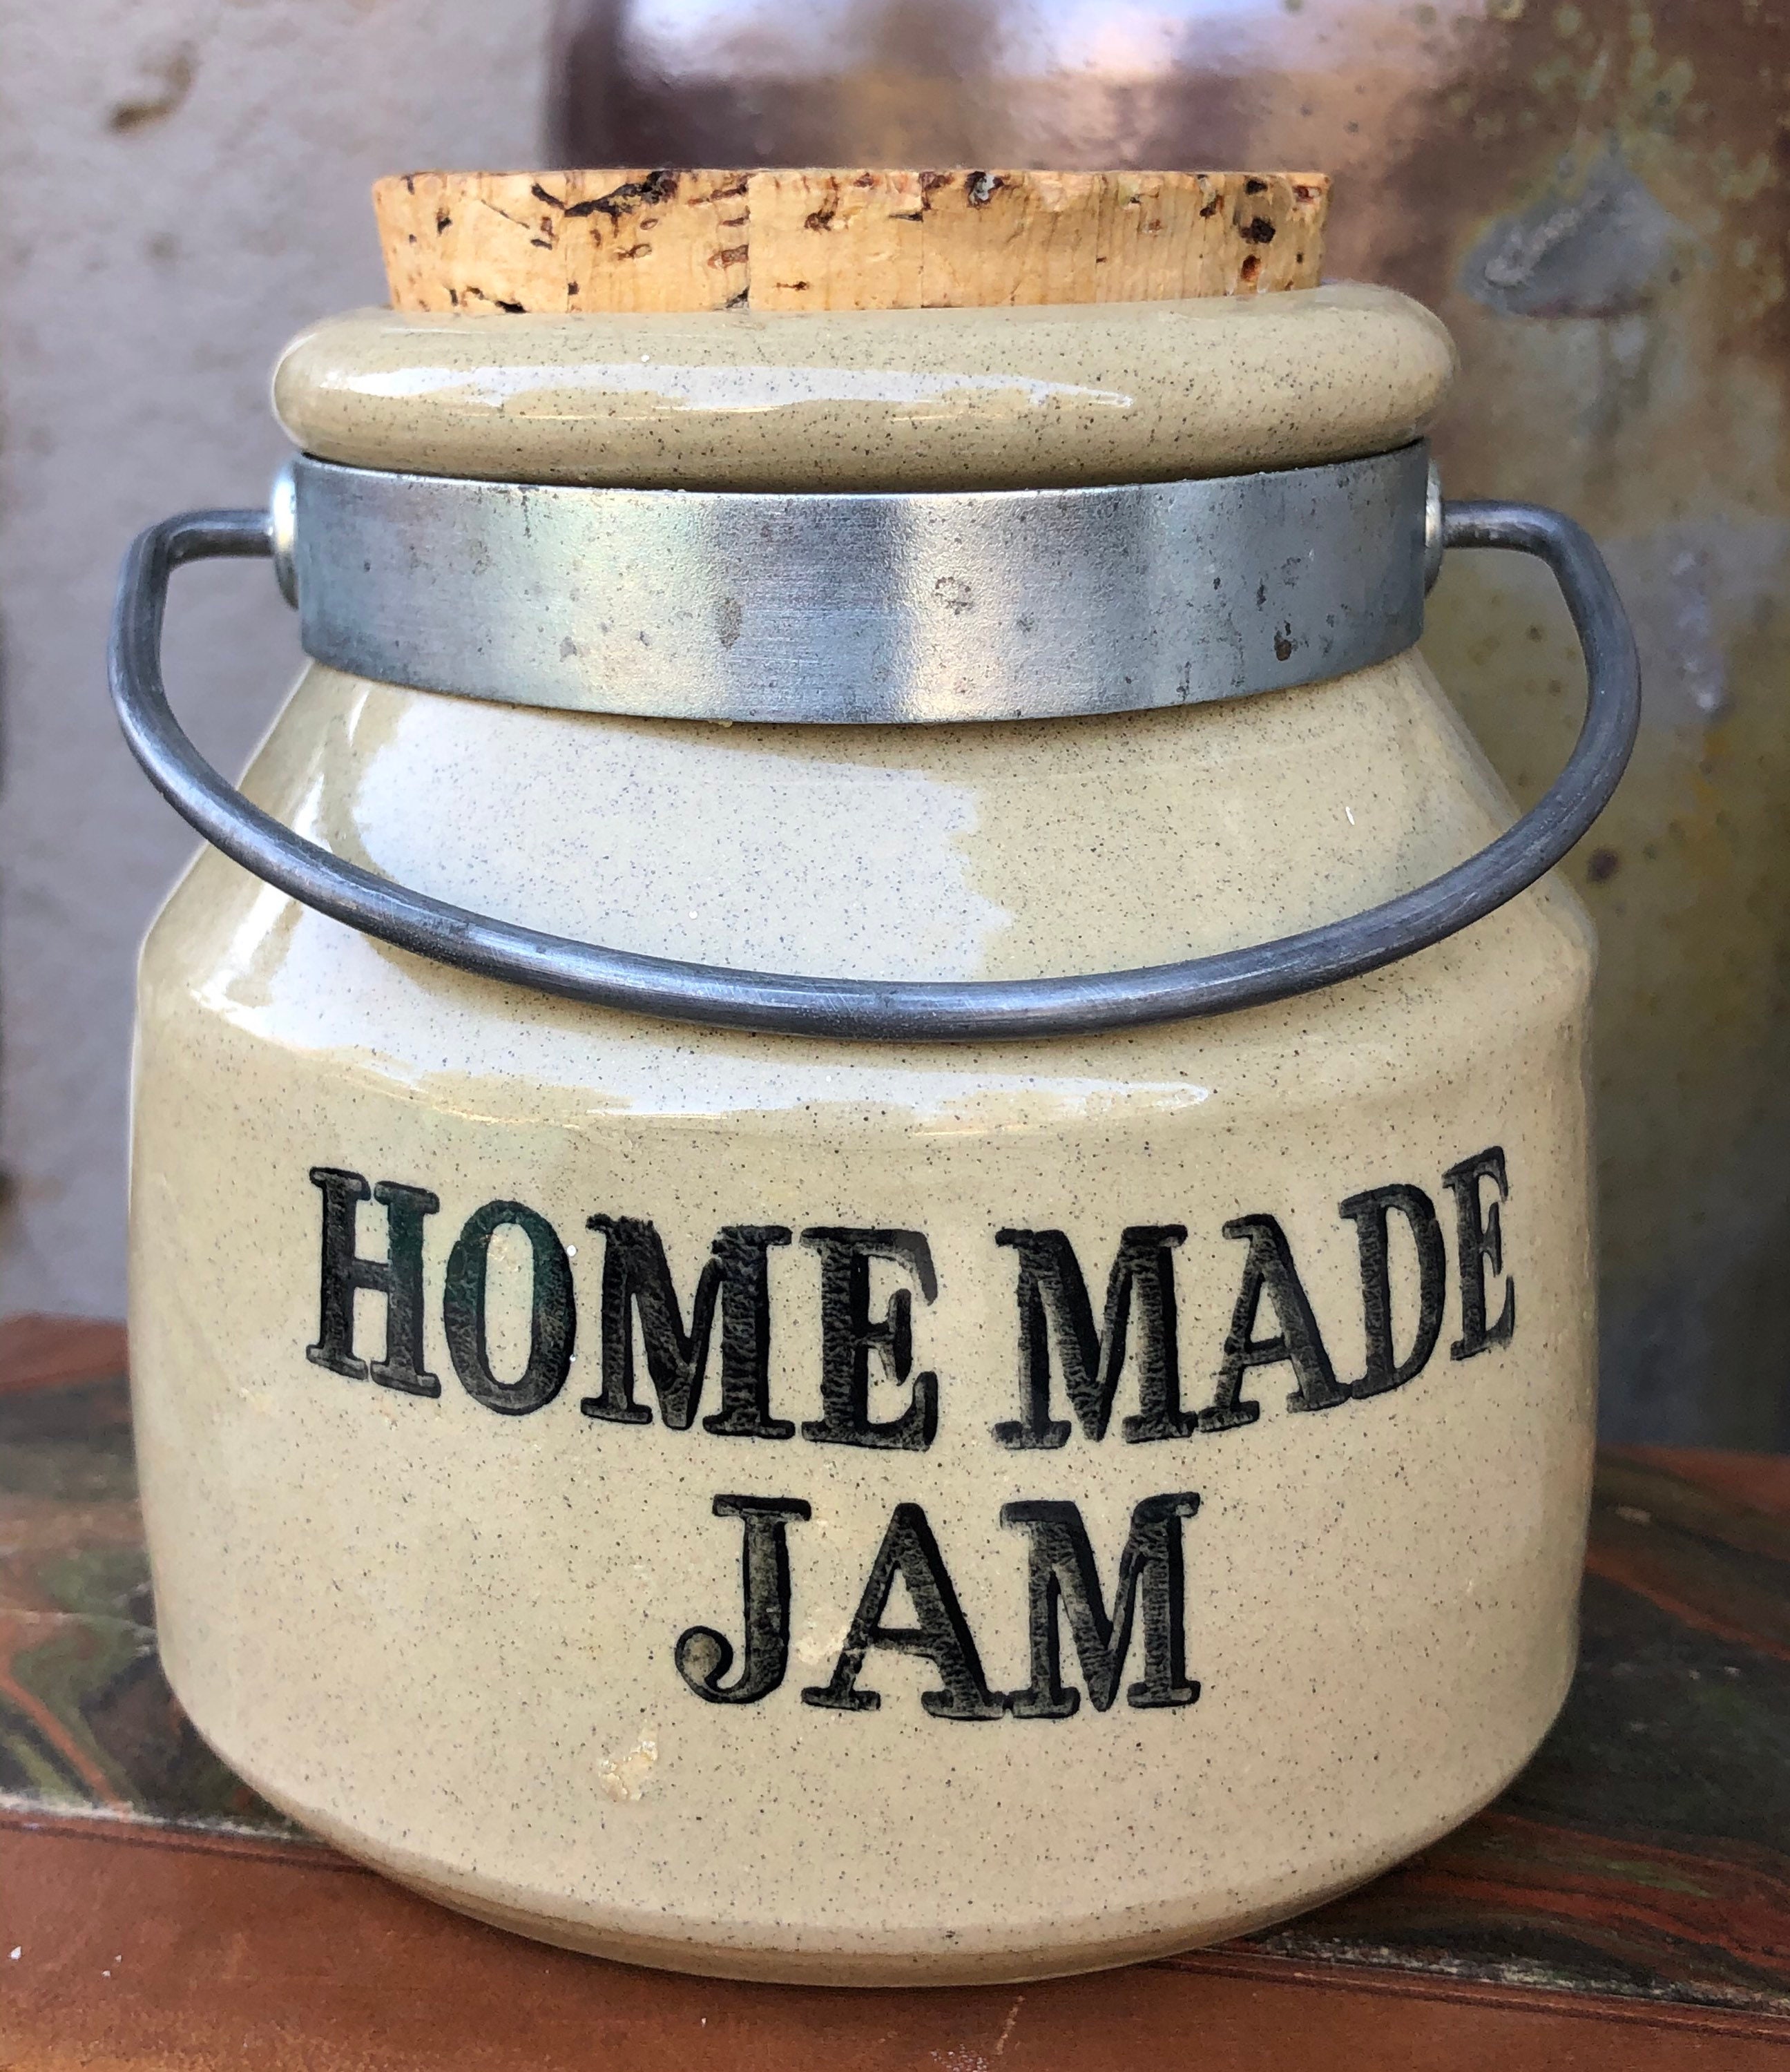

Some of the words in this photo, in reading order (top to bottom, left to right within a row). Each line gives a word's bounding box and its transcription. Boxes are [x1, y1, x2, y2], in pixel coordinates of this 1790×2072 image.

[306, 1166, 939, 1452] HOME
[992, 1145, 1516, 1450] MADE
[674, 1490, 1204, 1722] JAM
